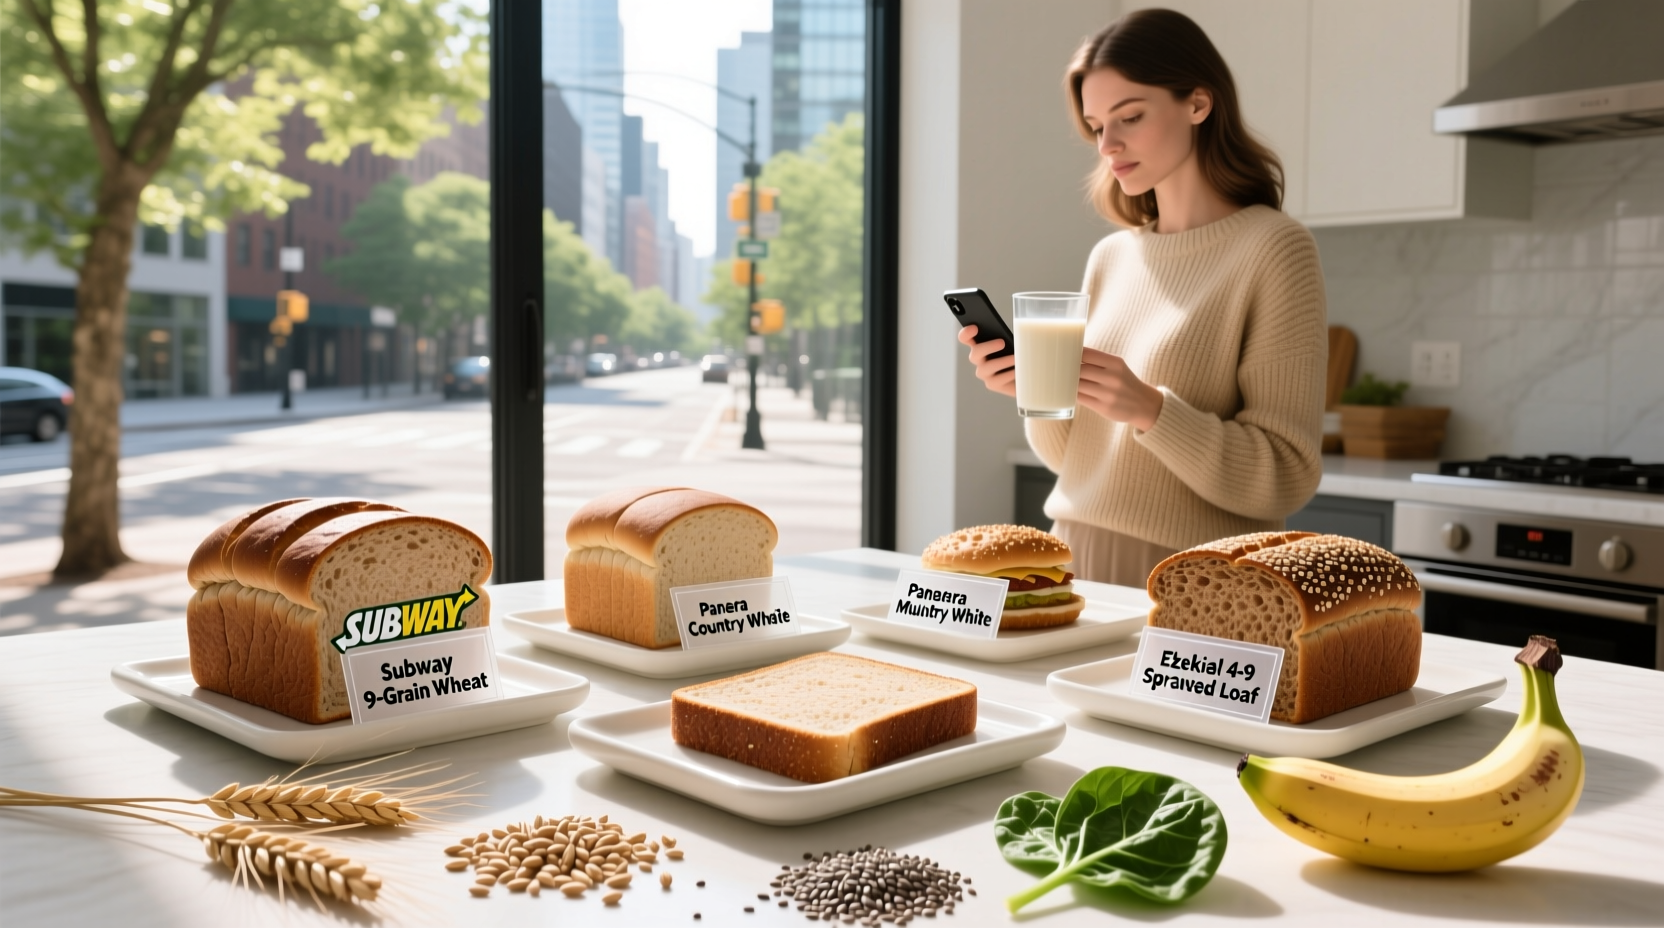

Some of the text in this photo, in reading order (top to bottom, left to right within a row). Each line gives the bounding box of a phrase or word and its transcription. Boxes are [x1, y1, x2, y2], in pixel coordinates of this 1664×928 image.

[699, 600, 748, 617] Panera
[952, 607, 992, 627] White
[335, 587, 478, 652] SUBWAY
[688, 618, 744, 637] Country
[380, 656, 453, 681] Subway
[1226, 661, 1256, 681] 4-9
[363, 672, 489, 709] 9-Grain Wheat
[1219, 682, 1261, 704] Loaf
